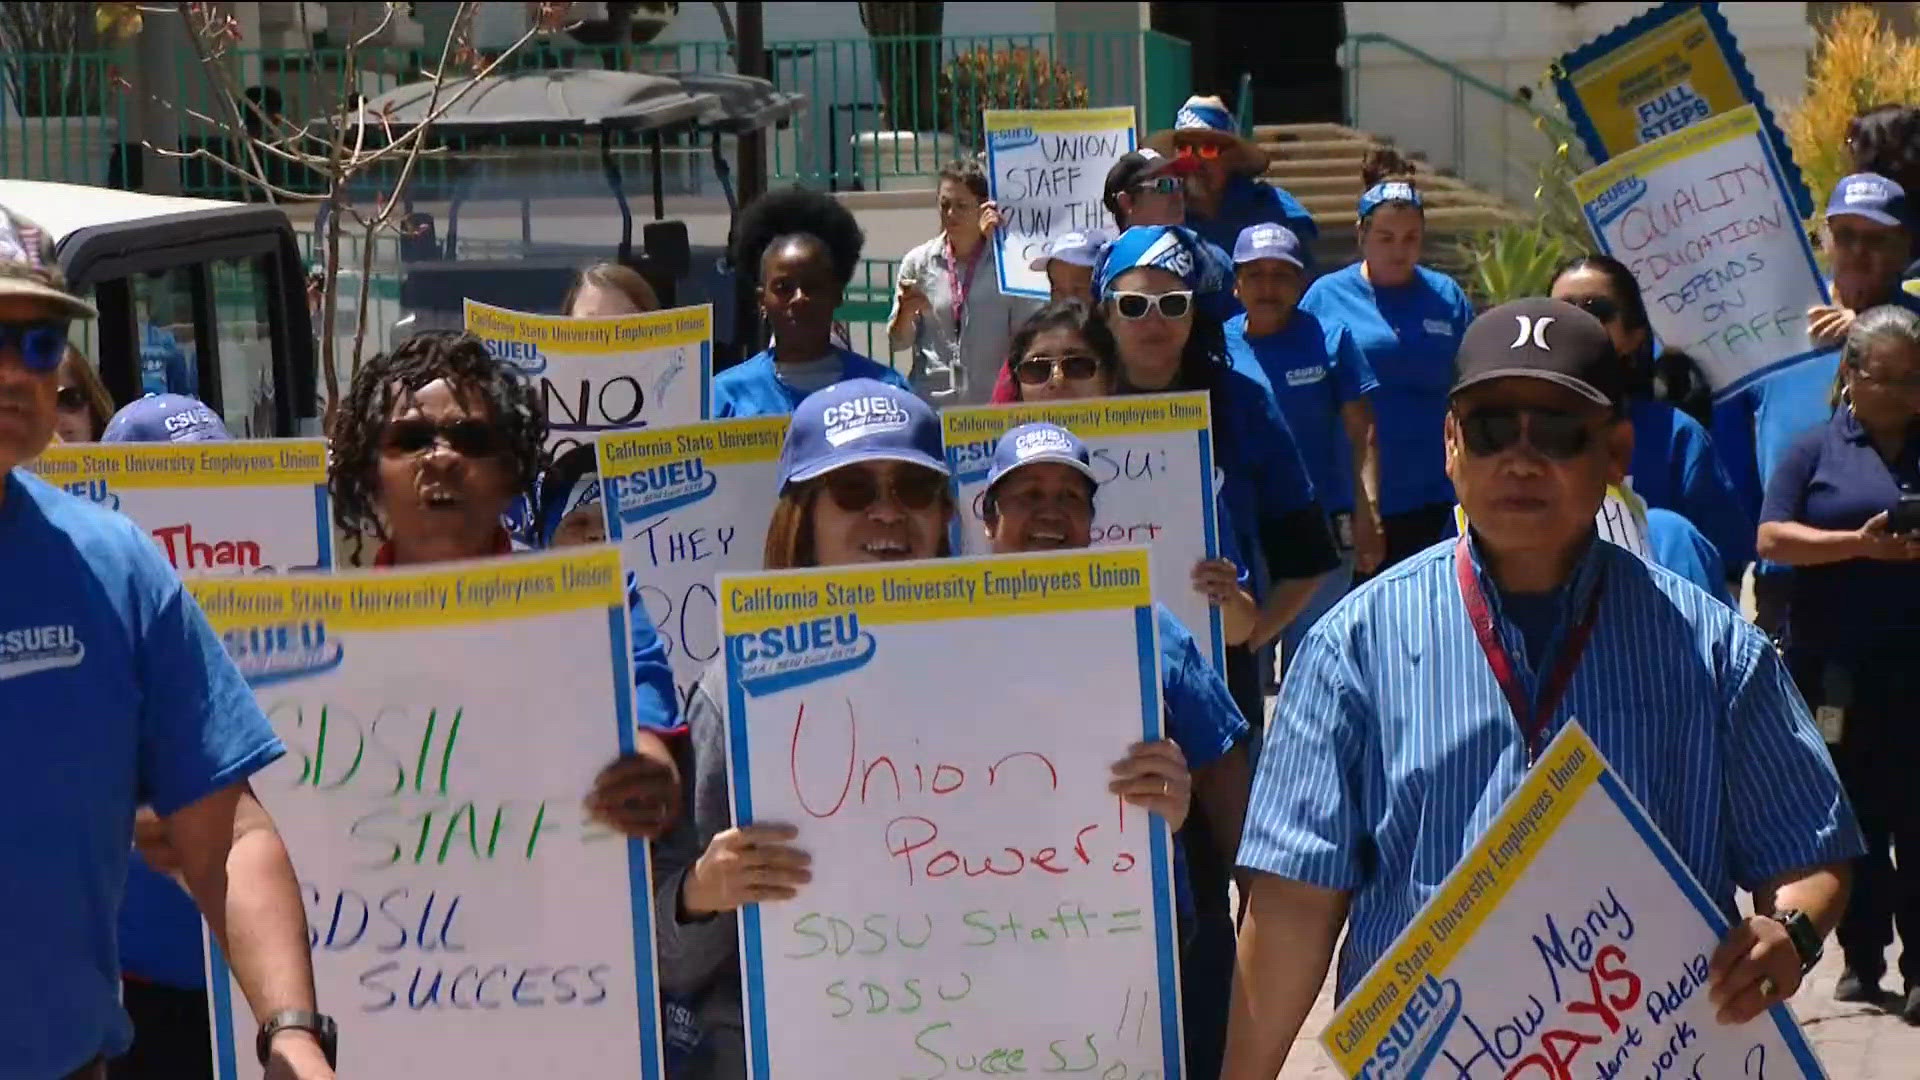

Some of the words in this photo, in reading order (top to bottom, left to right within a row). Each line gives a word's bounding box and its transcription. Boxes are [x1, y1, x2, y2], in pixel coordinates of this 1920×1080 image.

[1638, 86, 1695, 123] FULL
[1642, 98, 1709, 142] STEPS
[1041, 134, 1118, 162] UNION
[1006, 167, 1082, 200] STAFF
[1620, 161, 1769, 251] QUALITY
[1631, 202, 1782, 293] EDUCATION
[1657, 253, 1765, 314] DEPENDS
[1703, 290, 1745, 322] ON
[484, 340, 537, 360] SUEU
[519, 321, 548, 342] State
[552, 326, 609, 345] University
[615, 321, 673, 341] Employees
[676, 316, 704, 332] Union
[541, 375, 644, 425] NO
[949, 415, 1003, 433] California
[1105, 403, 1165, 424] Employees
[1170, 401, 1202, 417] Union
[82, 455, 120, 474] State
[125, 452, 196, 475] University
[200, 451, 275, 476] Employees
[280, 449, 320, 470] Union
[605, 438, 673, 463] California
[677, 434, 714, 454] State
[718, 428, 779, 451] University
[609, 458, 703, 499] CSUEU
[153, 523, 260, 569] Than
[633, 516, 735, 567] THEY
[291, 586, 342, 614] State
[350, 582, 448, 612] University
[456, 576, 555, 603] Employees
[562, 562, 613, 589] Union
[732, 587, 819, 612] California
[826, 583, 876, 607] State
[883, 576, 976, 604] University
[984, 570, 1081, 600] Employees
[1089, 563, 1141, 589] Union
[735, 612, 858, 662] CSUEU
[792, 697, 1057, 817] Union
[1335, 980, 1400, 1055] California
[1396, 940, 1435, 985] State
[1430, 865, 1498, 943] University
[1488, 789, 1556, 872] Employees
[1548, 746, 1587, 792] Union
[784, 912, 932, 959] SDSU
[963, 902, 1098, 946] Staff
[360, 960, 611, 1013] SUCCESS
[825, 973, 971, 1018] SDSU
[1443, 995, 1545, 1080] How
[1532, 886, 1634, 1003] Many
